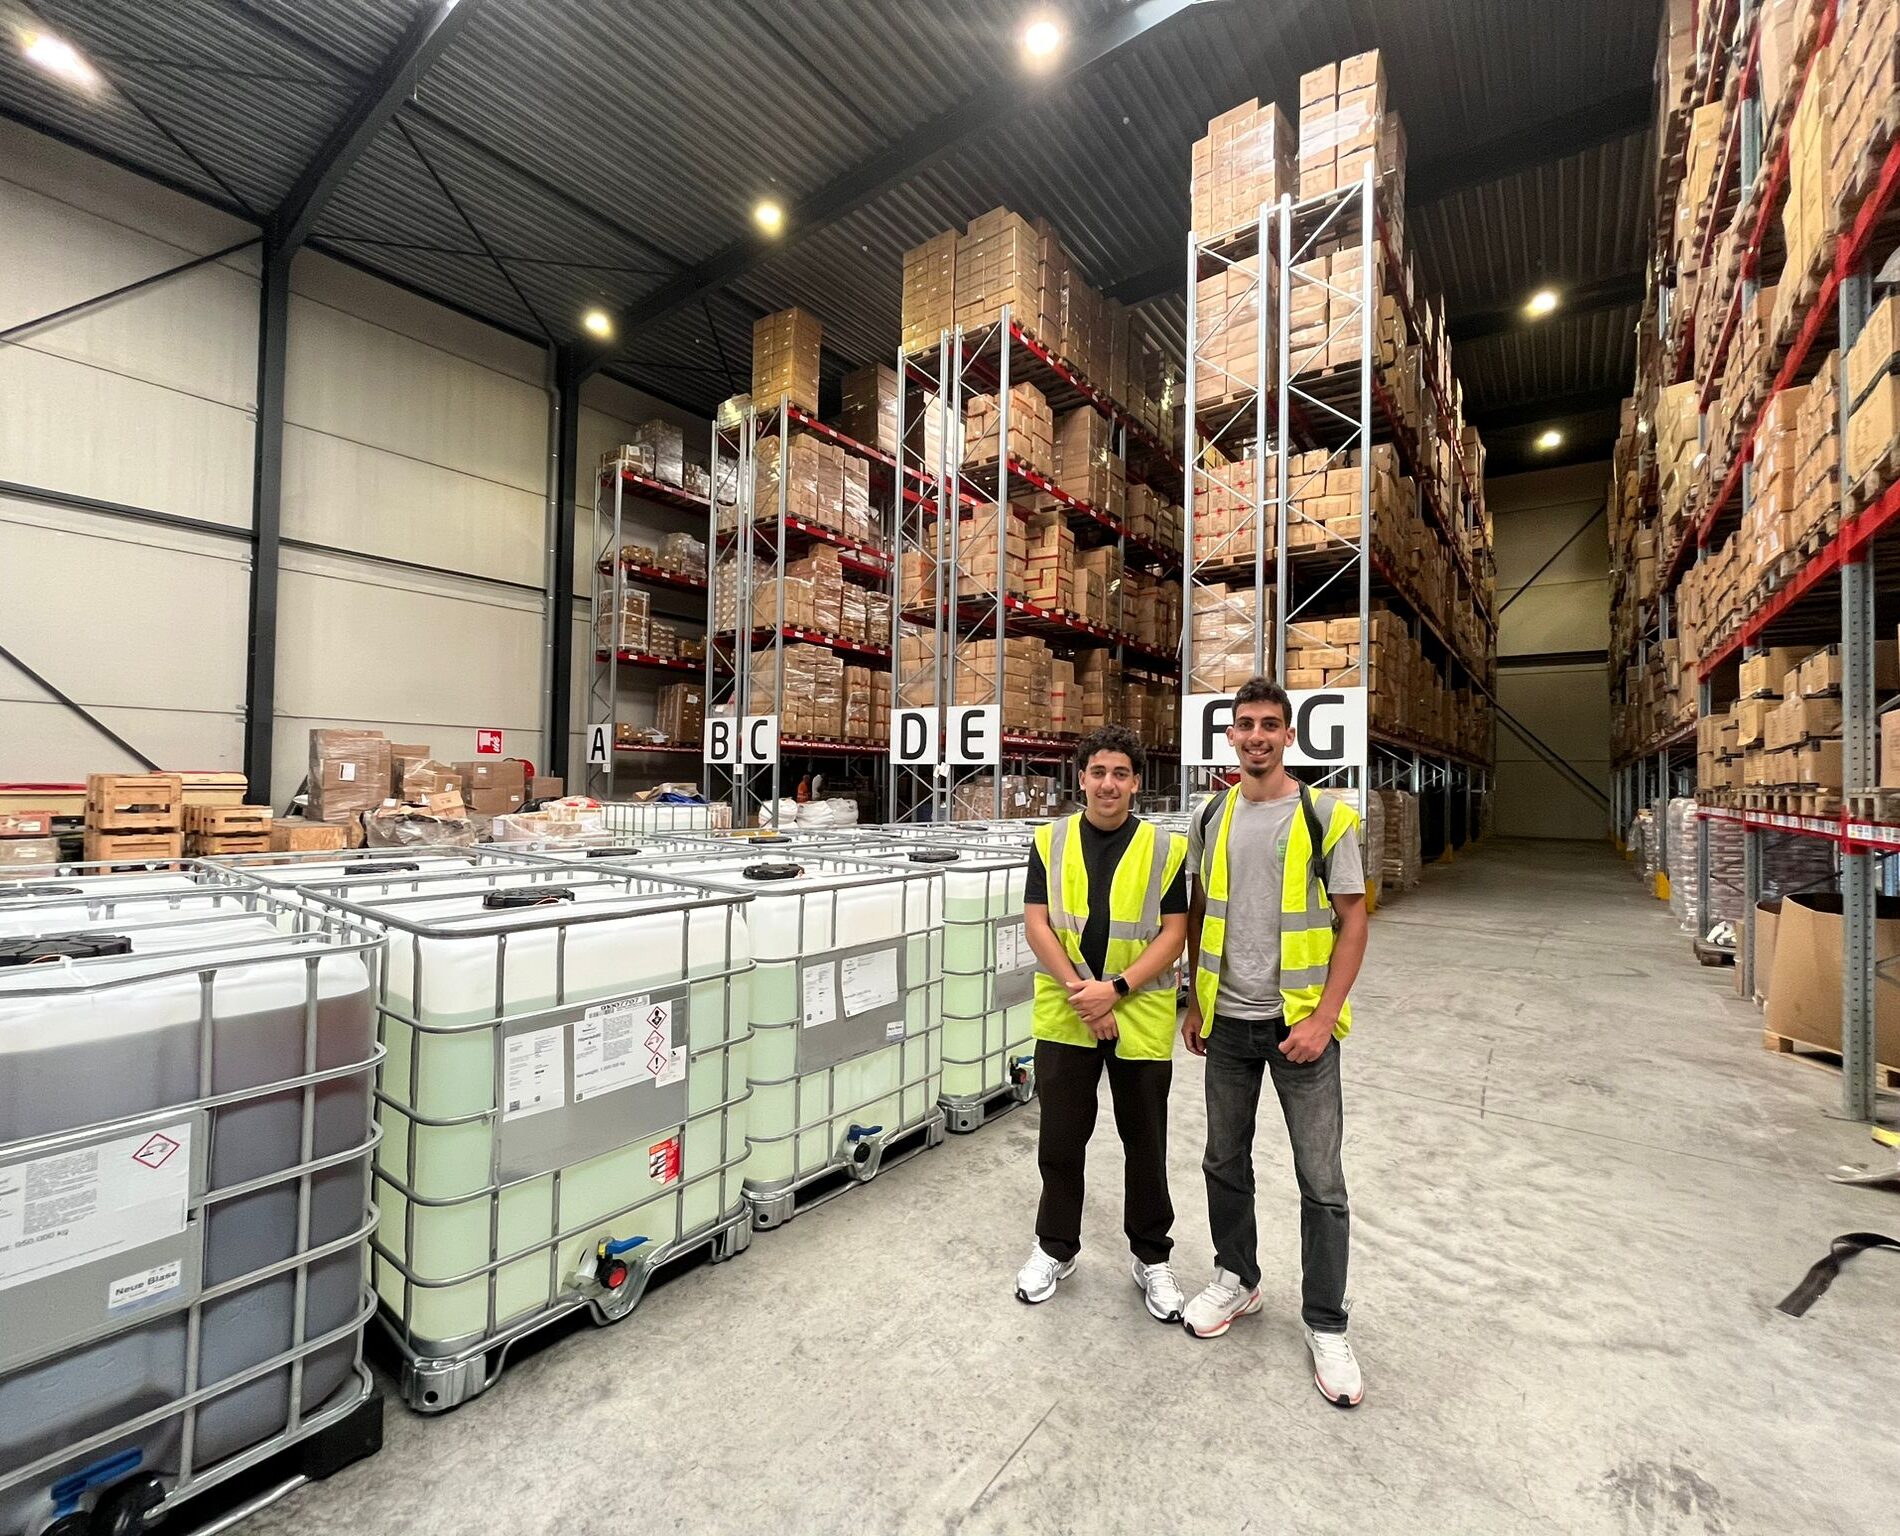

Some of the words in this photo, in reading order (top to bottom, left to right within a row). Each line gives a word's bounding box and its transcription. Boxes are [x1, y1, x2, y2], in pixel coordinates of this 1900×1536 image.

[591, 727, 606, 761] A
[711, 721, 729, 760] B
[751, 719, 768, 760] C
[901, 712, 927, 760] D
[961, 710, 985, 760] E
[1297, 694, 1345, 760] G
[115, 1281, 145, 1296] Neue
[147, 1270, 178, 1285] Blase
